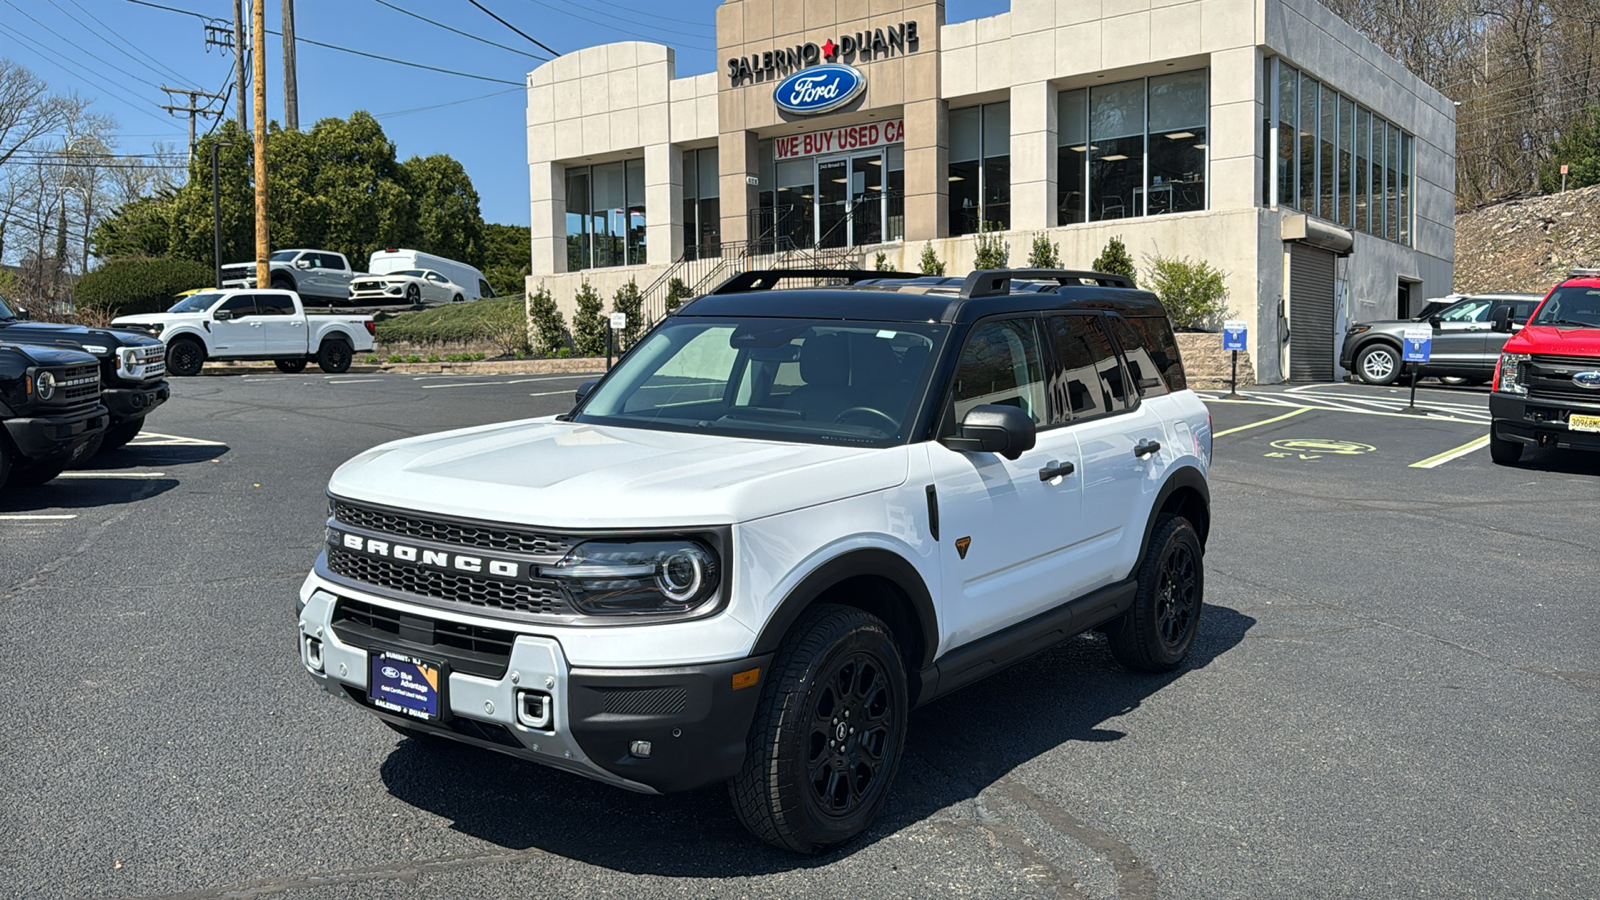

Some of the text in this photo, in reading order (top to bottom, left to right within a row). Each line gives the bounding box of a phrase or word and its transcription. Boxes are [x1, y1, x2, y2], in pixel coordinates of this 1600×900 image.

[728, 21, 918, 78] SALERNO DUANE
[790, 74, 840, 105] Ford
[776, 136, 799, 158] WE
[803, 130, 834, 154] BUY
[837, 124, 879, 150] USED
[344, 534, 518, 577] BRONCO
[400, 671, 413, 681] Blue
[400, 680, 427, 692] Advantage
[375, 699, 429, 719] SALERNO DUANE
